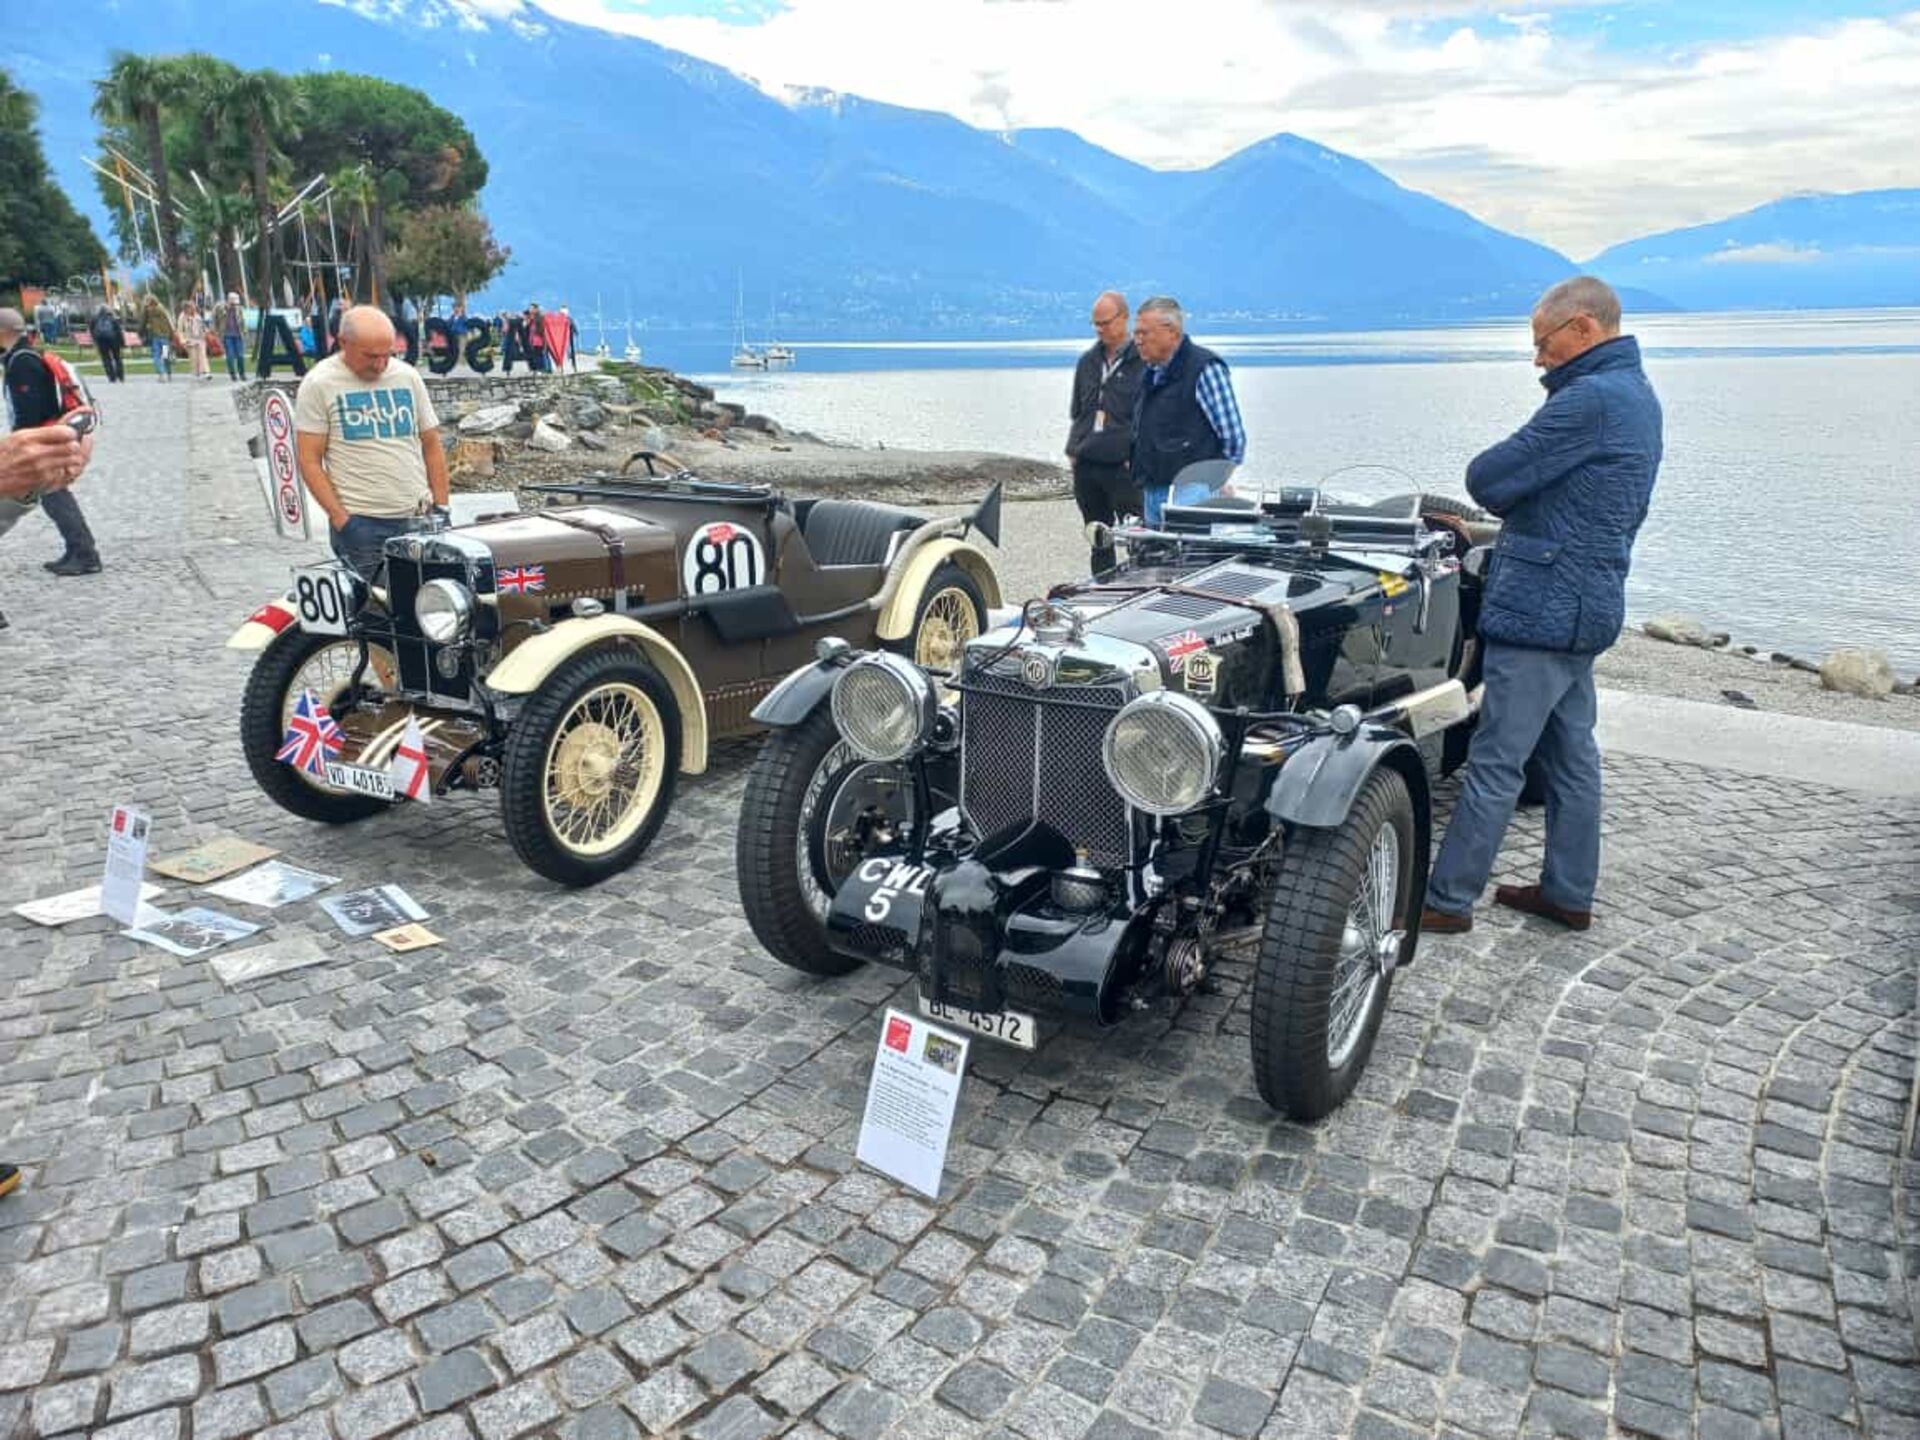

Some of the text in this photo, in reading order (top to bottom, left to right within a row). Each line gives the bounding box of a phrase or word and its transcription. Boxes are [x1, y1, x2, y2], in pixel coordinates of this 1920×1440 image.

[695, 533, 757, 595] 80
[297, 575, 340, 624] 80
[859, 857, 933, 895] CWL
[864, 886, 898, 922] 5
[967, 1009, 1022, 1043] 4572
